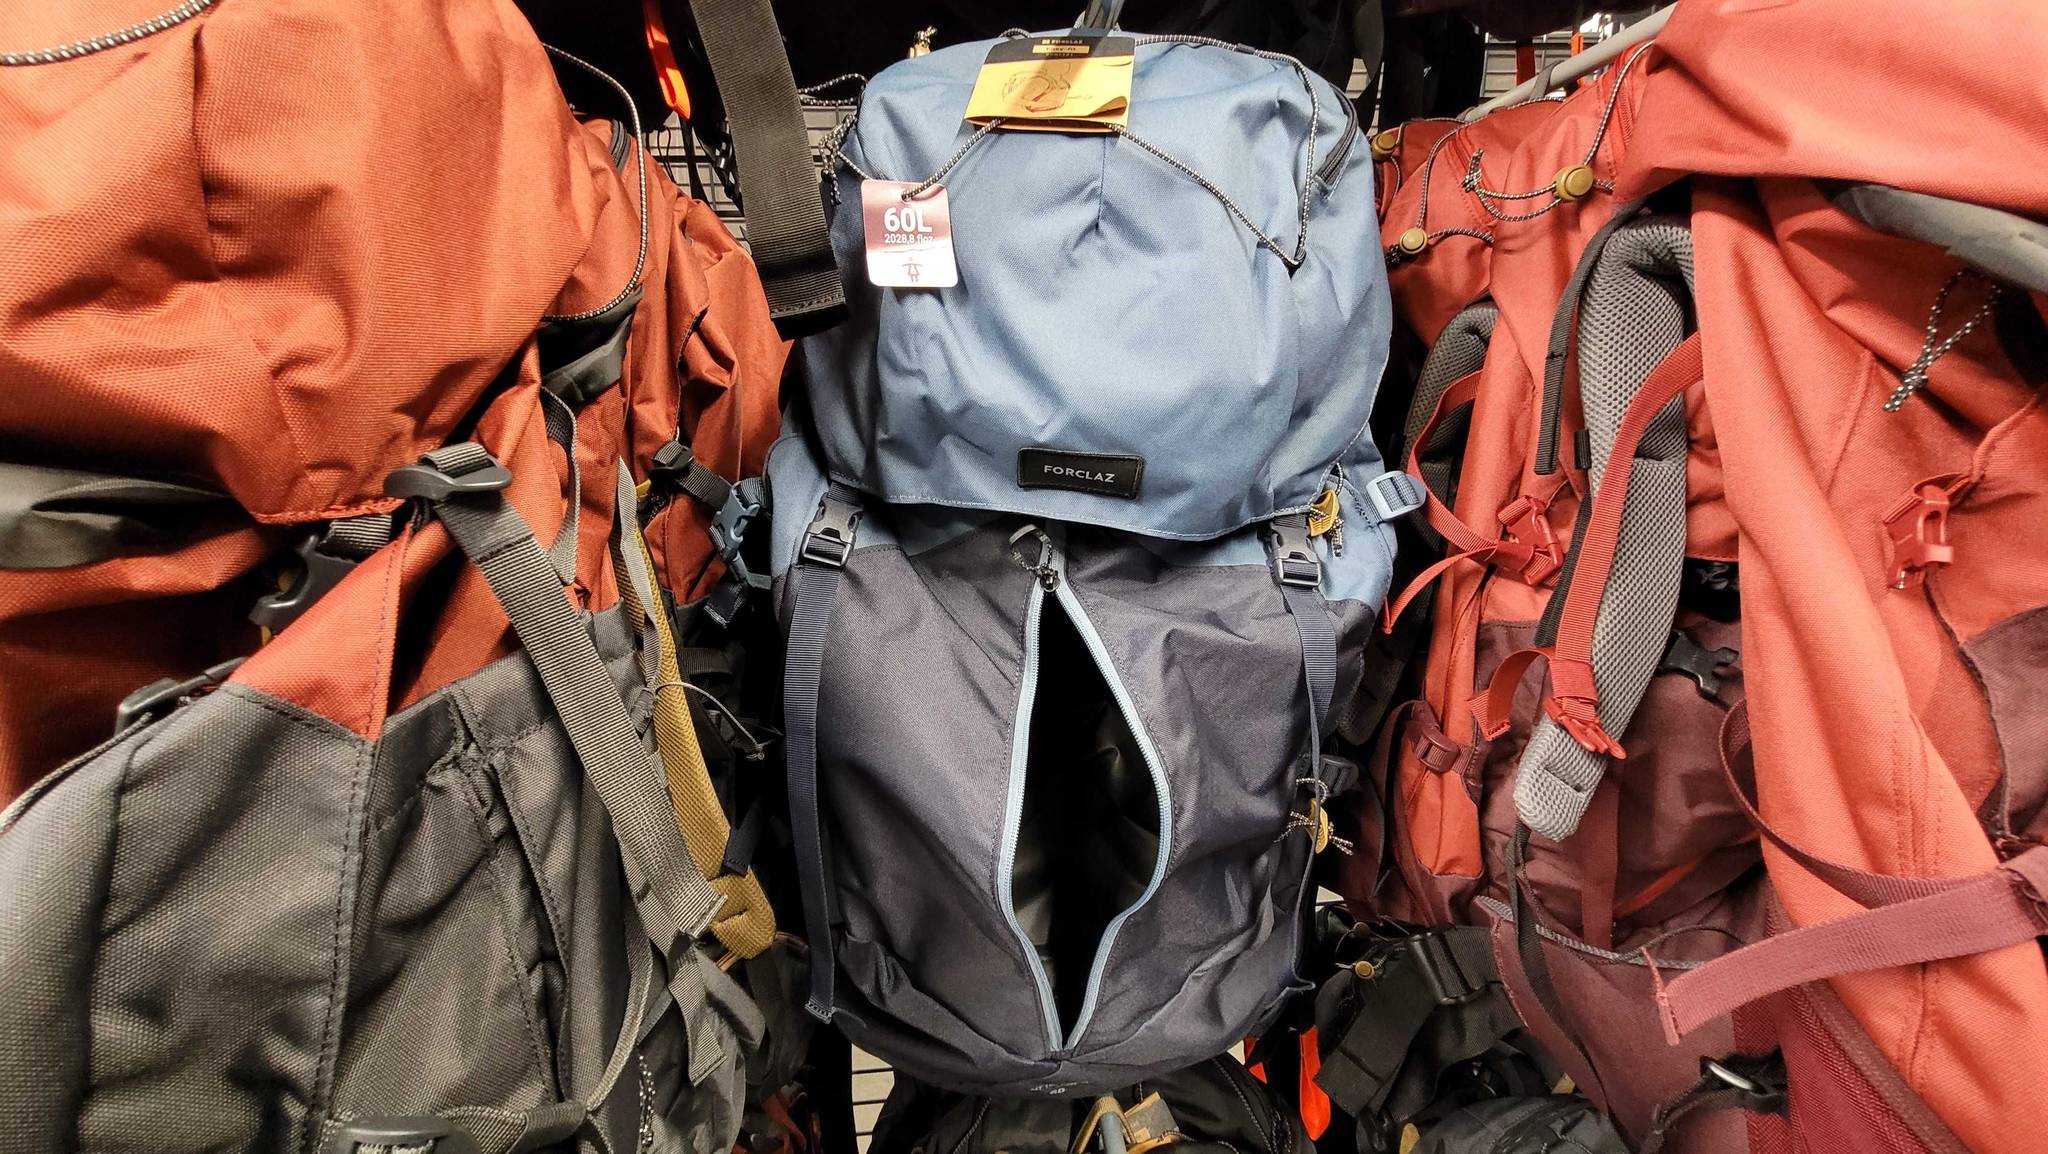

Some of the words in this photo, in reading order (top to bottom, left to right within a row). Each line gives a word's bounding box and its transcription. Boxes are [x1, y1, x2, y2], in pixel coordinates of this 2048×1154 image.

[884, 207, 933, 233] 60L
[884, 233, 915, 245] 2028,8
[1043, 464, 1116, 483] FORCLAZ
